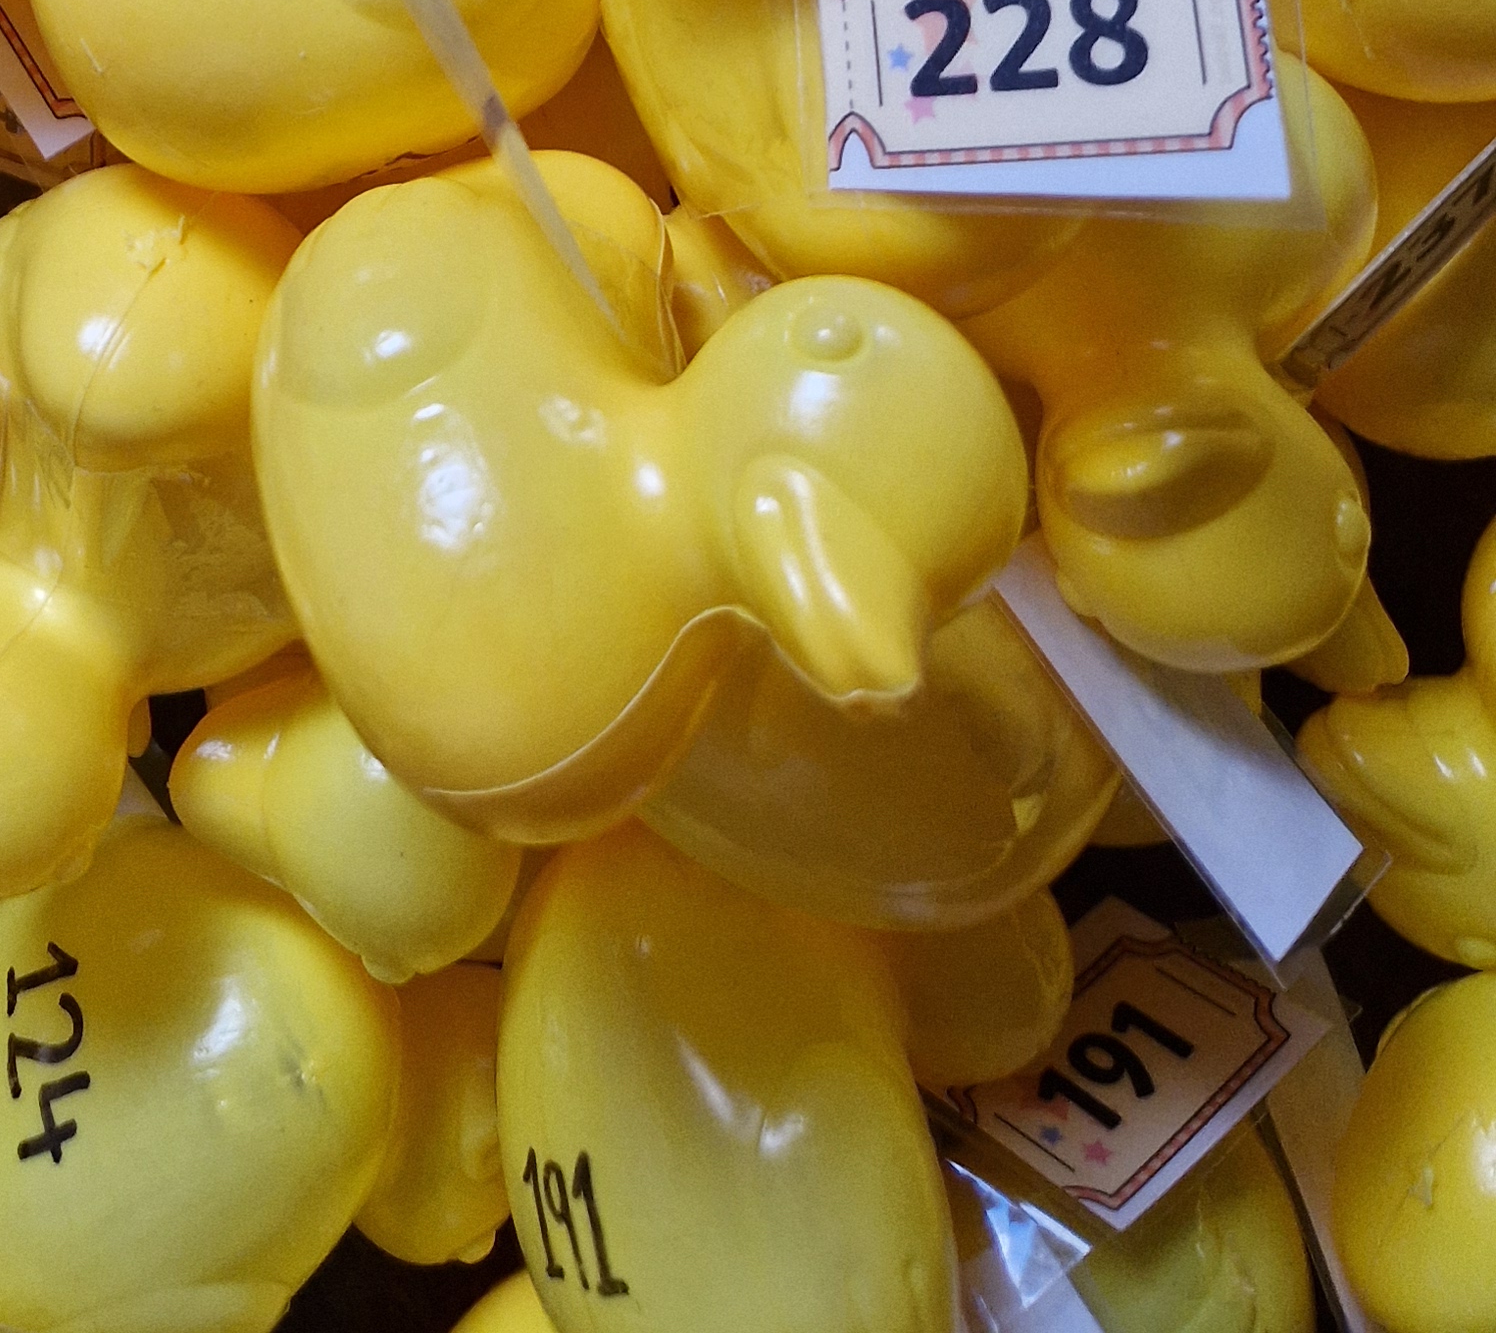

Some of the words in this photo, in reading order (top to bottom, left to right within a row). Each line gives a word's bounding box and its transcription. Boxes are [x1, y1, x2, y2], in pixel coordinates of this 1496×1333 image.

[5, 941, 91, 1164] 124
[1037, 999, 1195, 1133] 191
[523, 1147, 630, 1297] 191
